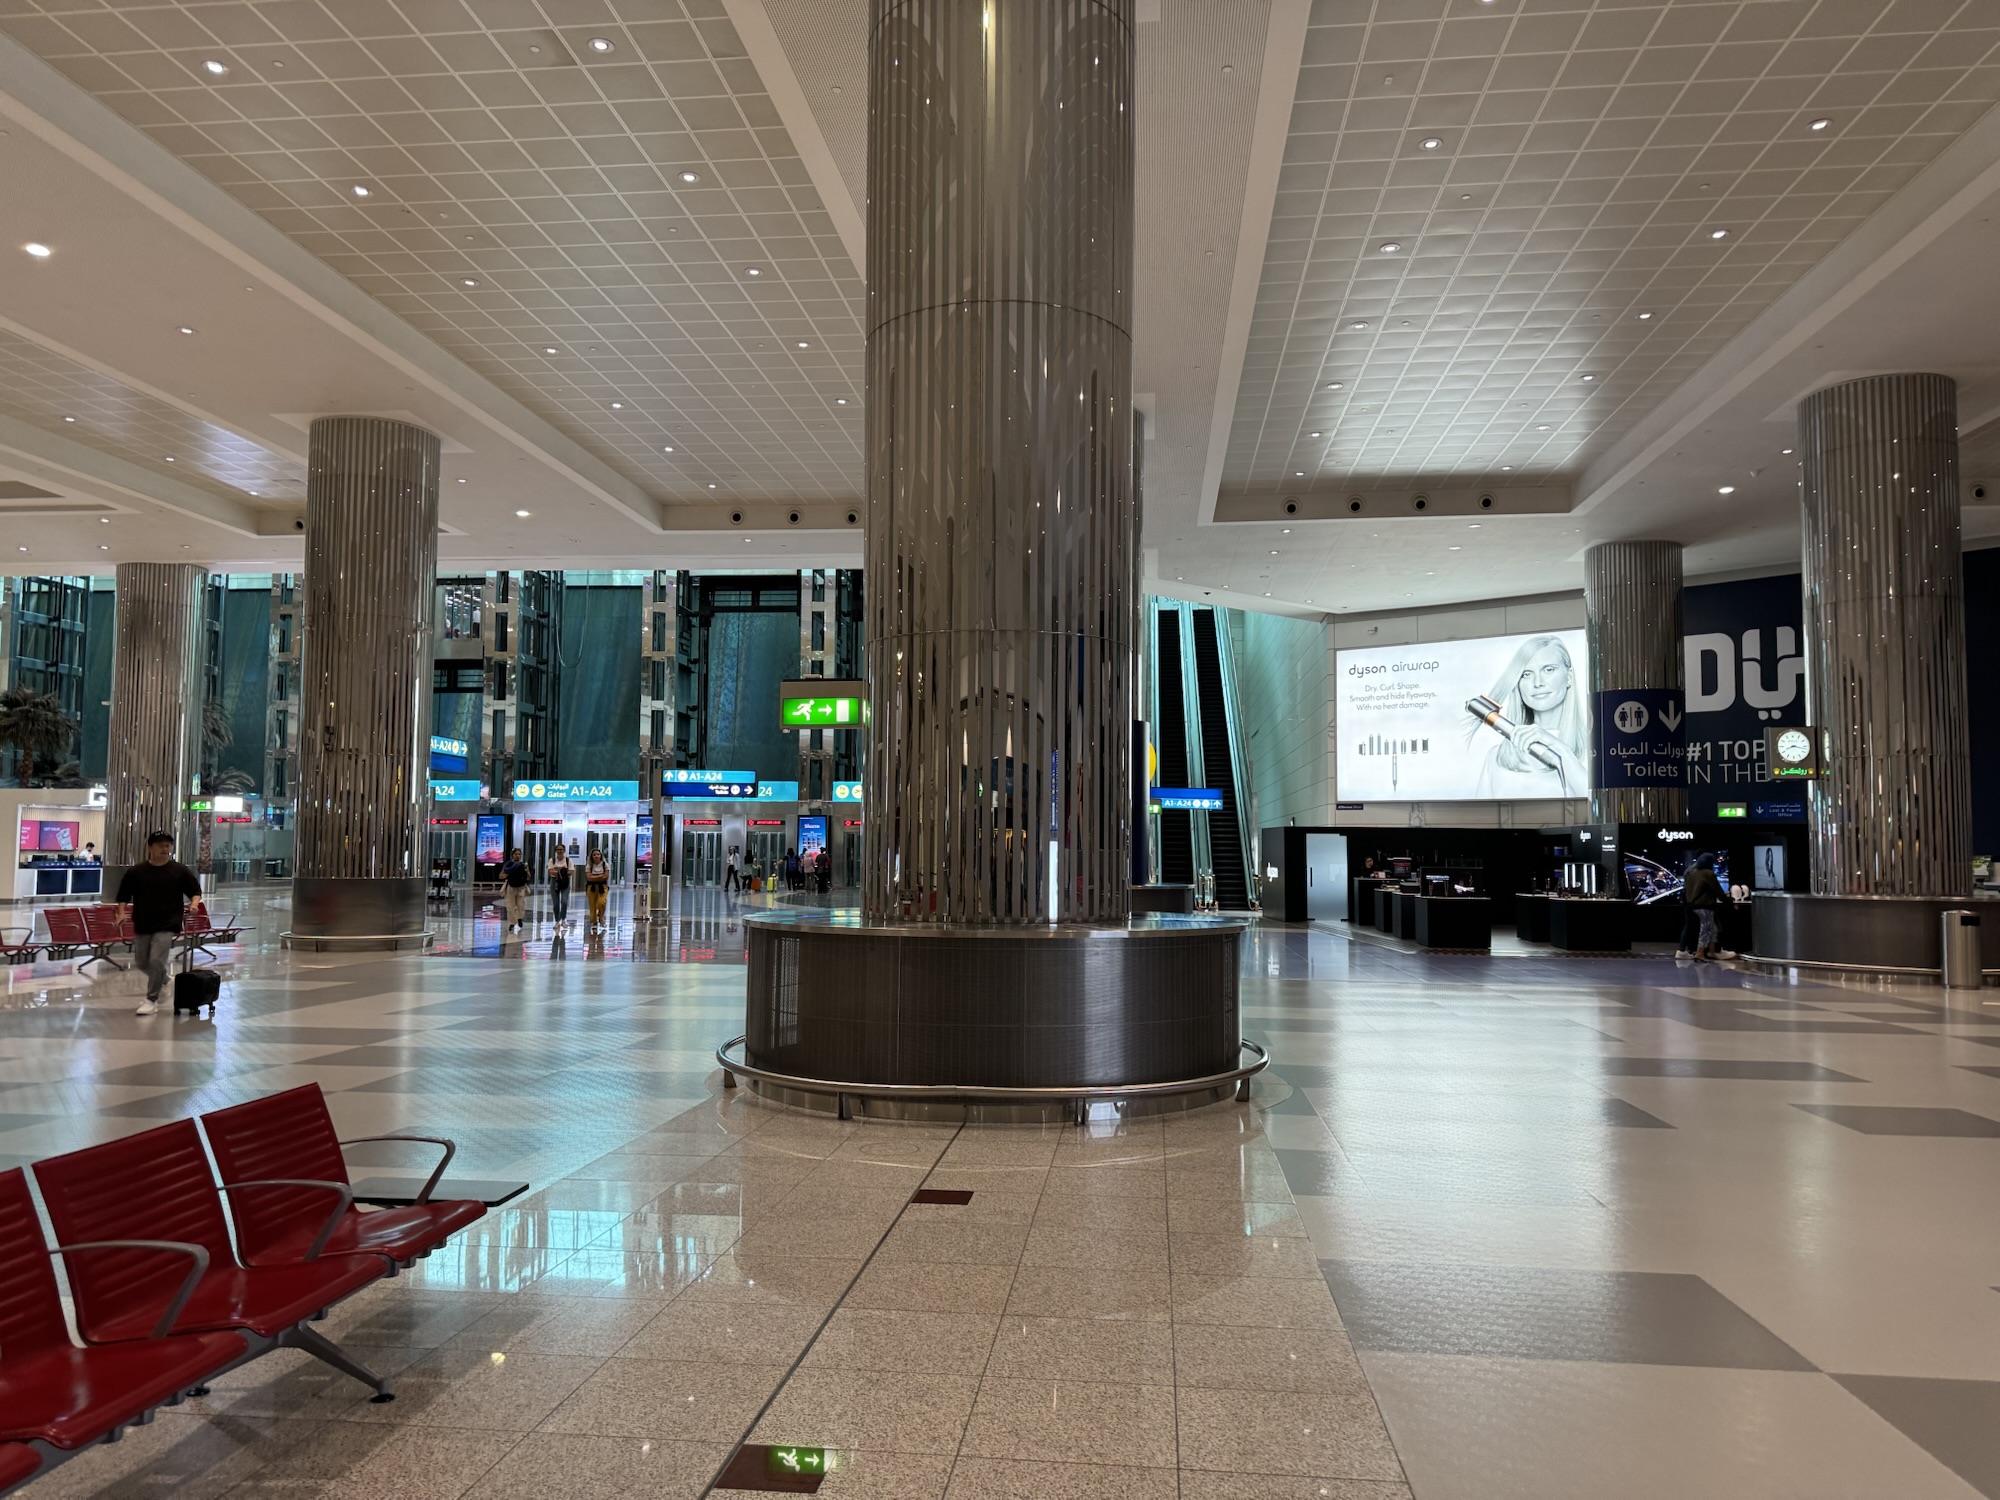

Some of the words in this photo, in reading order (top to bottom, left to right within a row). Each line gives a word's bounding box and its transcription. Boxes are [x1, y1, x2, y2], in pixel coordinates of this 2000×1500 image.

[1348, 664, 1387, 678] dyson
[1391, 661, 1440, 672] airwrap
[1379, 683, 1395, 691] Curl.
[1397, 682, 1421, 690] Shape.
[1349, 694, 1375, 702] Smooth
[1390, 692, 1405, 700] hide
[1406, 691, 1437, 700] flyaways.
[1399, 701, 1430, 710] damage.
[1609, 742, 1648, 761] المياه
[1653, 742, 1685, 758] دورات
[1687, 742, 1712, 761] #1
[1718, 739, 1765, 760] TOP
[689, 772, 722, 780] A1-A24
[1623, 762, 1678, 777] Toilets
[1687, 764, 1711, 784] IN
[1718, 762, 1767, 783] THE
[571, 786, 612, 796] A1-A24
[1164, 799, 1191, 807] A1-A24
[1658, 828, 1694, 842] dyson
